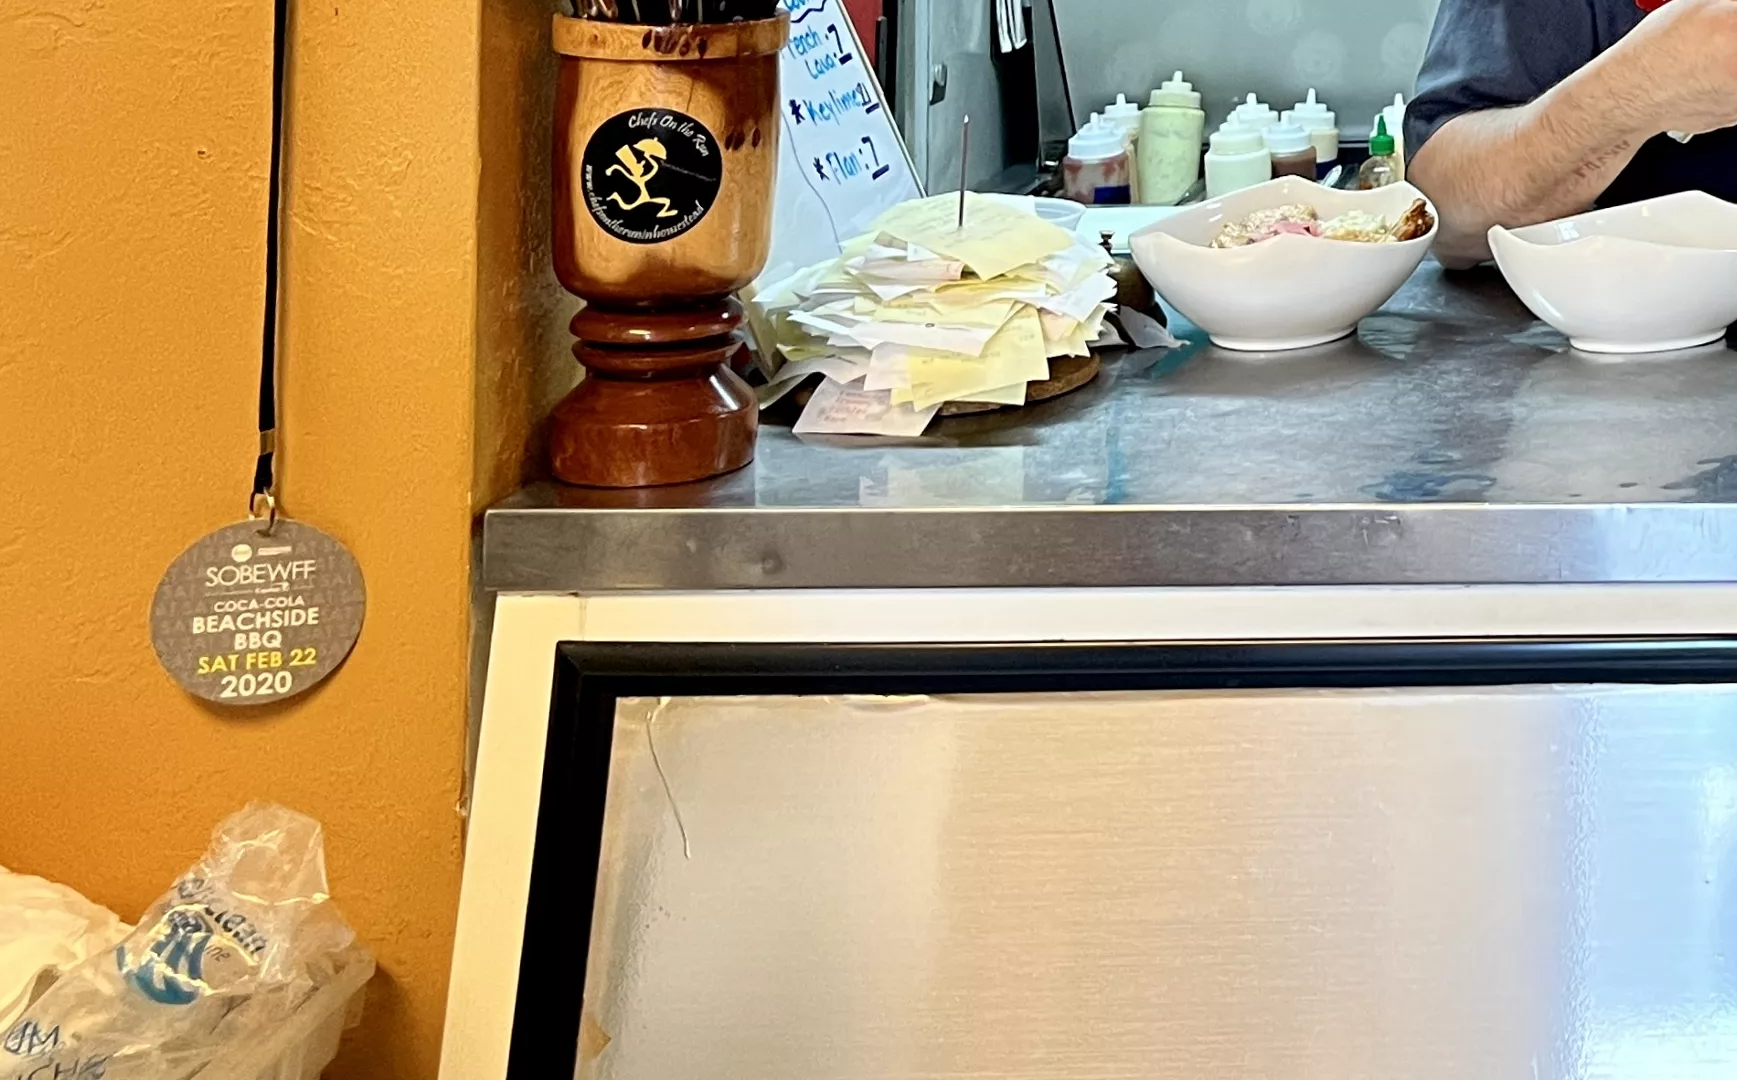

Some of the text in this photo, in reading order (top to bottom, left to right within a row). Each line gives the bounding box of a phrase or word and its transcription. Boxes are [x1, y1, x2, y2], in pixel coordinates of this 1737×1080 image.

[628, 112, 710, 157] Chefs On Run
[206, 560, 316, 587] SOBEWFF
[214, 595, 305, 613] COCA-COLA
[192, 607, 319, 635] BEACHSIDE
[234, 630, 282, 650] BBQ
[198, 647, 316, 675] SAT FEB 22
[220, 671, 292, 698] 2020
